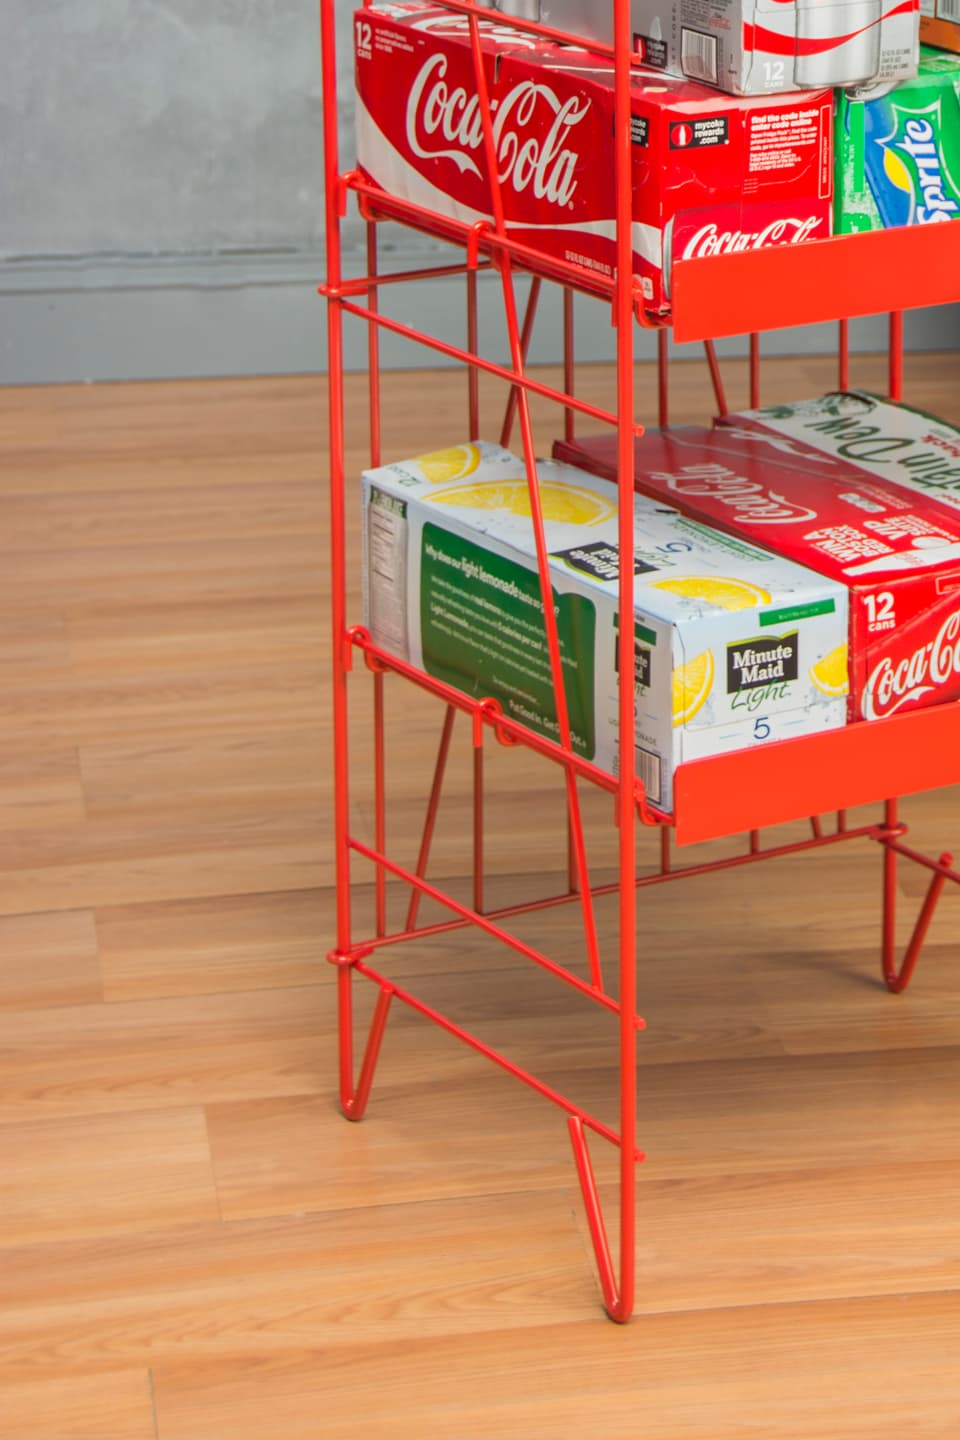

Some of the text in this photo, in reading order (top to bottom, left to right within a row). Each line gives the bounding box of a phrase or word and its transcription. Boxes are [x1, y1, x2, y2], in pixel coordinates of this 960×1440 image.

[356, 21, 373, 51] 12
[763, 61, 785, 82] 12
[694, 119, 725, 131] mycoke
[767, 114, 780, 123] the
[780, 112, 799, 121] code
[771, 121, 790, 130] code
[694, 127, 725, 139] rewards
[699, 136, 719, 145] .com
[894, 118, 960, 226] Sprite
[803, 415, 915, 464] Dew
[820, 526, 880, 558] BOSTON
[838, 523, 896, 555] RED SOX
[862, 519, 908, 541] VIP
[803, 529, 861, 563] WIN A
[461, 556, 480, 579] light
[479, 565, 520, 598] lemonade
[863, 591, 896, 623] 12
[868, 618, 896, 632] cans
[732, 644, 793, 670] Minute
[741, 660, 785, 685] Maid
[730, 678, 792, 712] Light
[753, 716, 771, 740] 5
